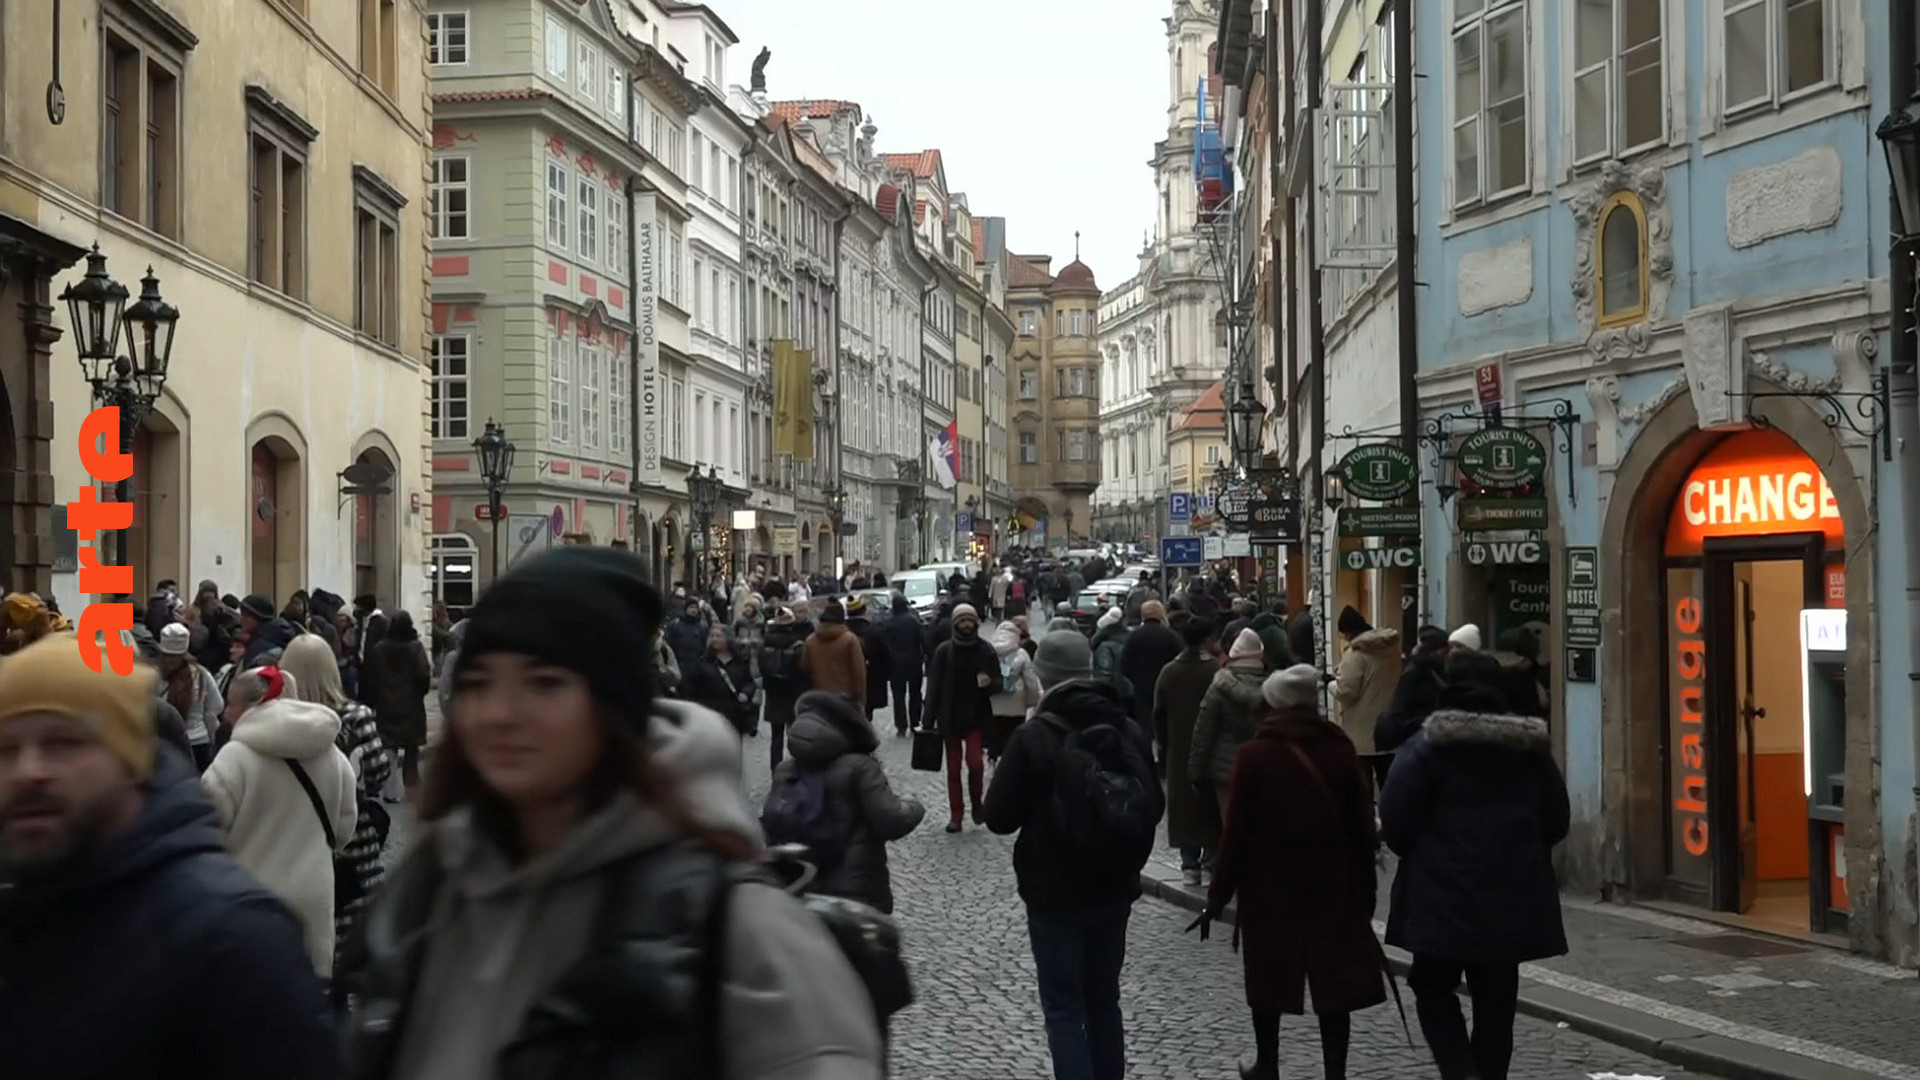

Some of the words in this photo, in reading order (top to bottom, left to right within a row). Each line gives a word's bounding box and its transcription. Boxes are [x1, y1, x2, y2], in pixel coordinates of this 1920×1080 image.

[640, 222, 653, 292] BALTHASAR
[641, 295, 653, 345] DOMUS
[643, 366, 655, 416] HOTEL
[644, 421, 656, 471] DESIGN
[1467, 430, 1511, 451] TOURIST
[1512, 431, 1536, 451] INFO
[1346, 447, 1386, 465] TOURIST
[1388, 448, 1410, 465] INFO
[1684, 471, 1841, 526] CHANGE
[1395, 513, 1418, 521] POINT
[1515, 508, 1543, 518] OFFICE
[1368, 547, 1415, 567] WC
[1490, 541, 1541, 564] WC
[1567, 589, 1598, 605] HOSTEL
[1675, 596, 1709, 856] change
